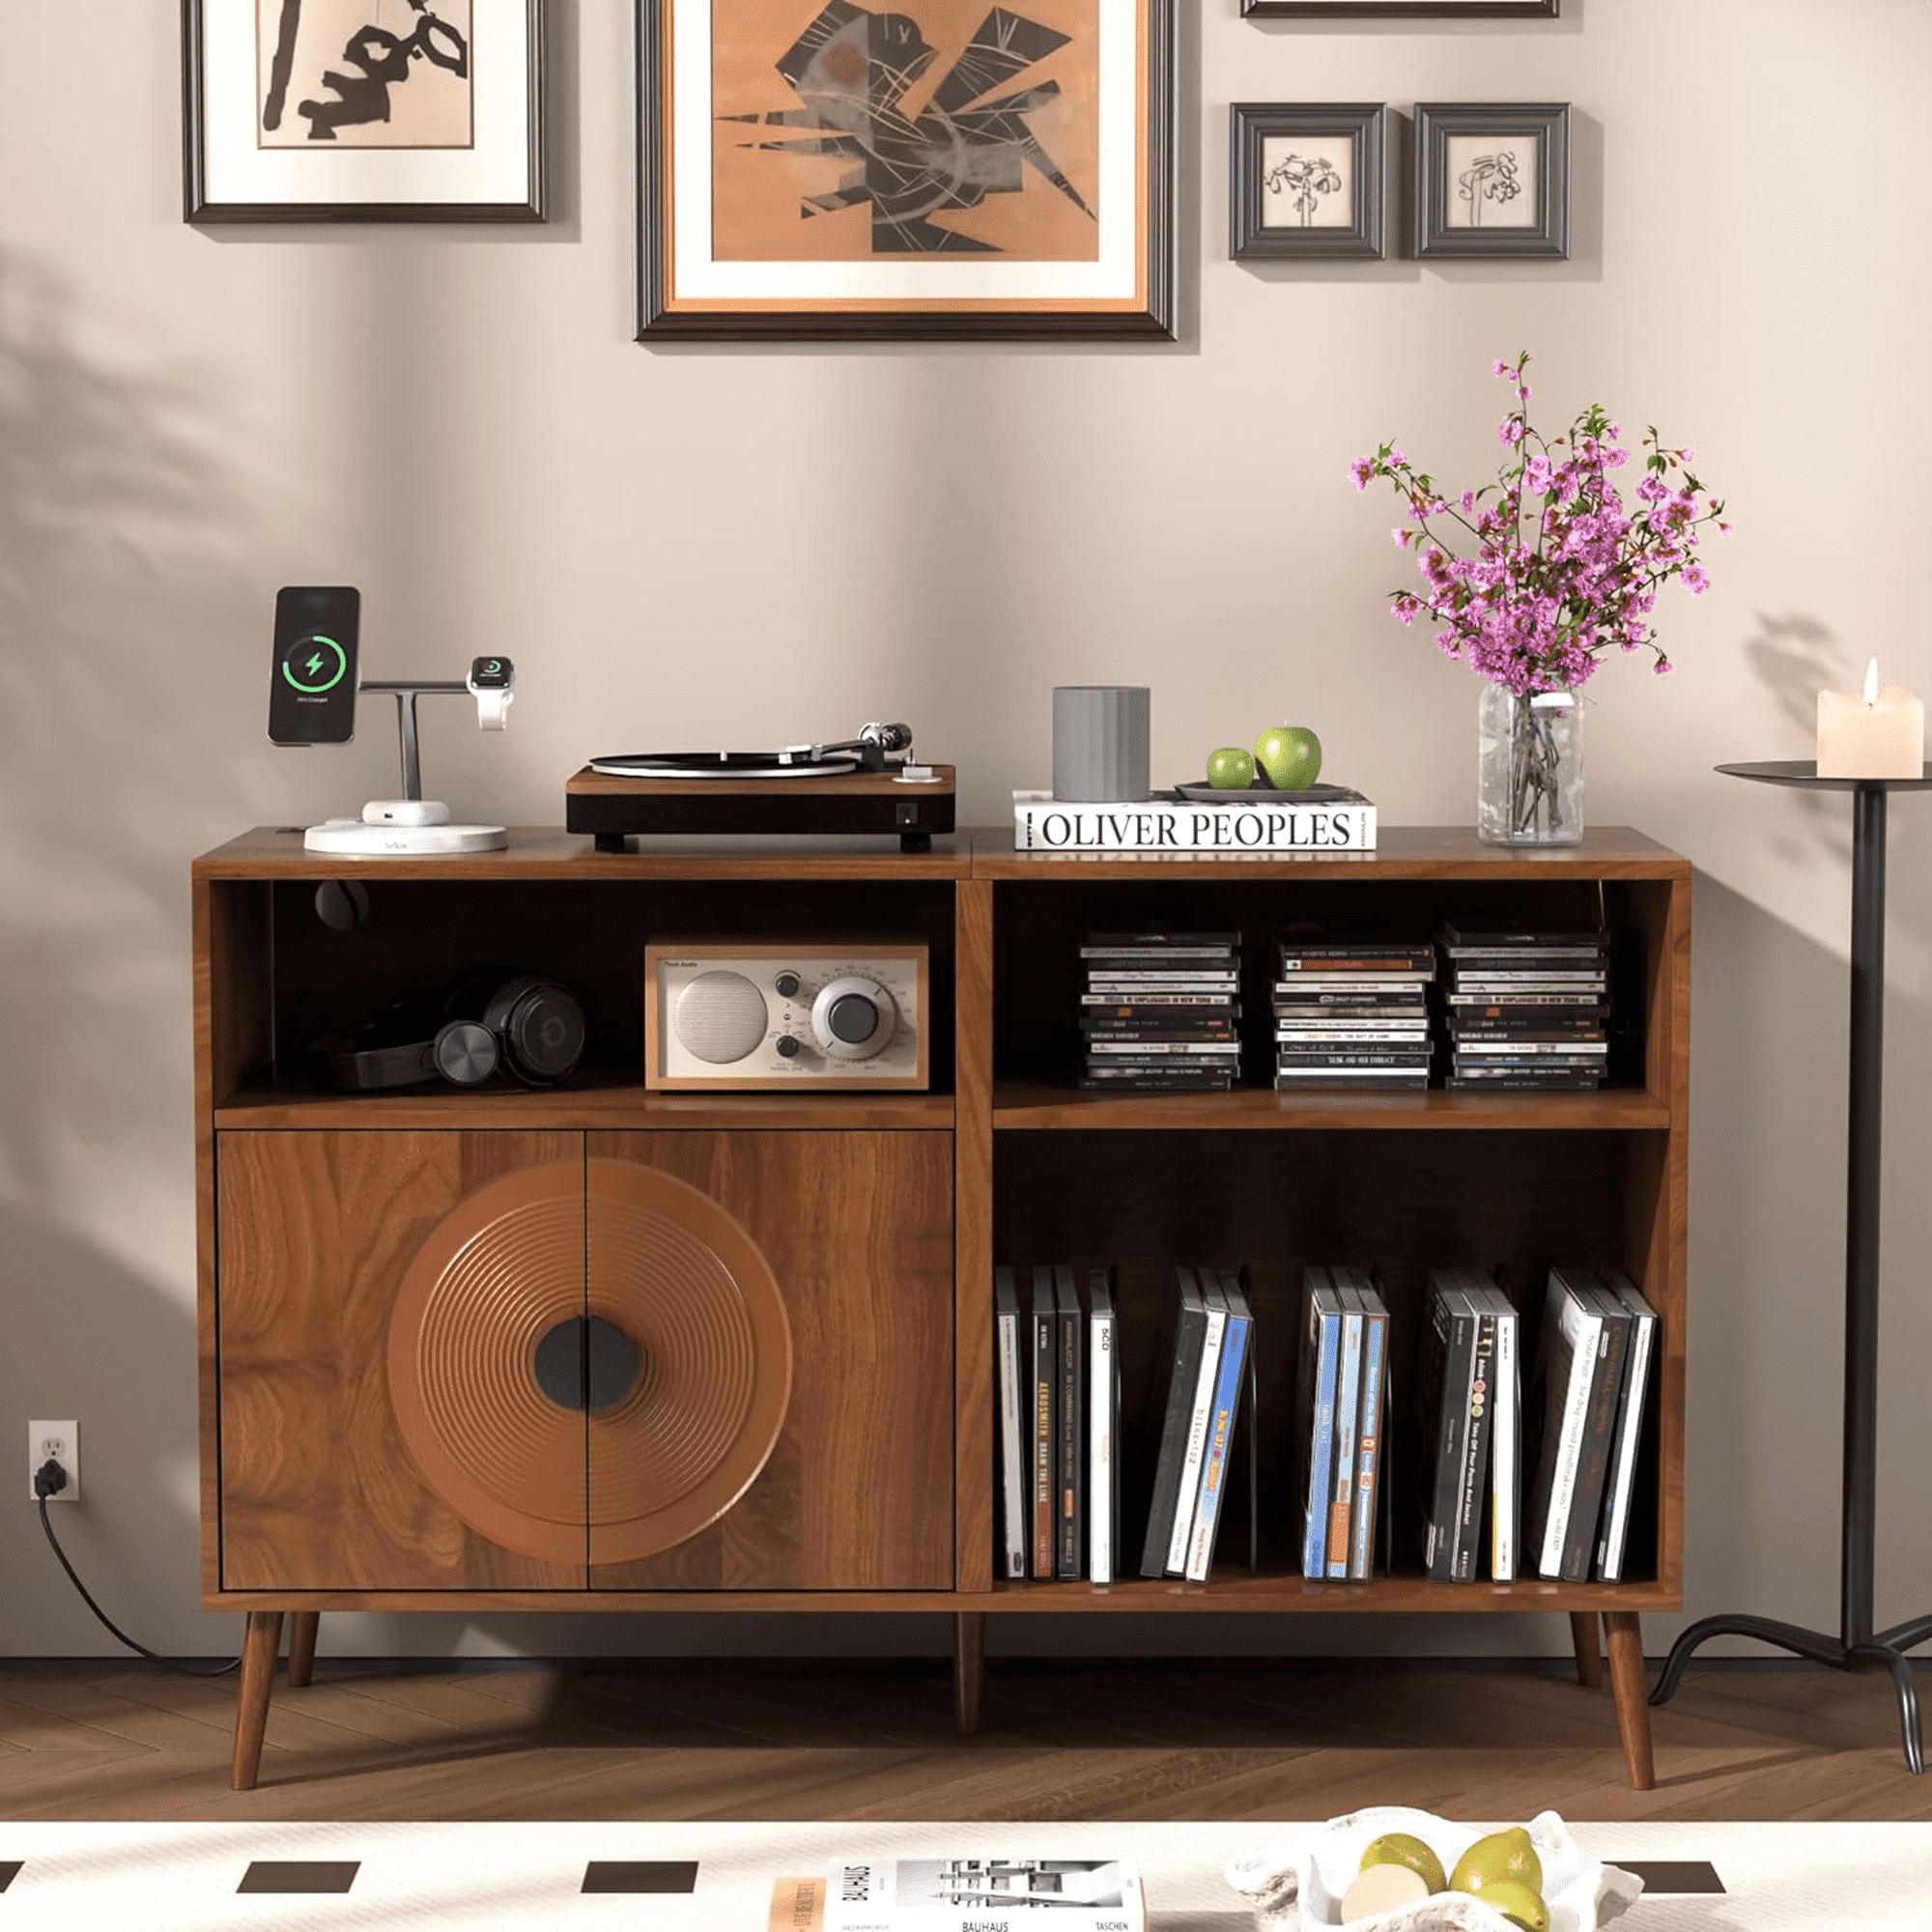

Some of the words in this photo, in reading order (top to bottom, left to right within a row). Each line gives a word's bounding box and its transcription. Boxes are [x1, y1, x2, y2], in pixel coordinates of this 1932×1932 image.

[1042, 813, 1179, 846] OLIVER
[1190, 813, 1350, 846] PEOPLES
[1101, 1327, 1110, 1351] 5CD
[1039, 1381, 1049, 1436] AEROSMITH
[1038, 1442, 1048, 1465] DRAW
[1038, 1467, 1048, 1482] THE
[1038, 1485, 1048, 1503] LINE
[962, 1921, 1009, 1932] BAUHAUS
[1095, 1921, 1129, 1931] TASCHEN
